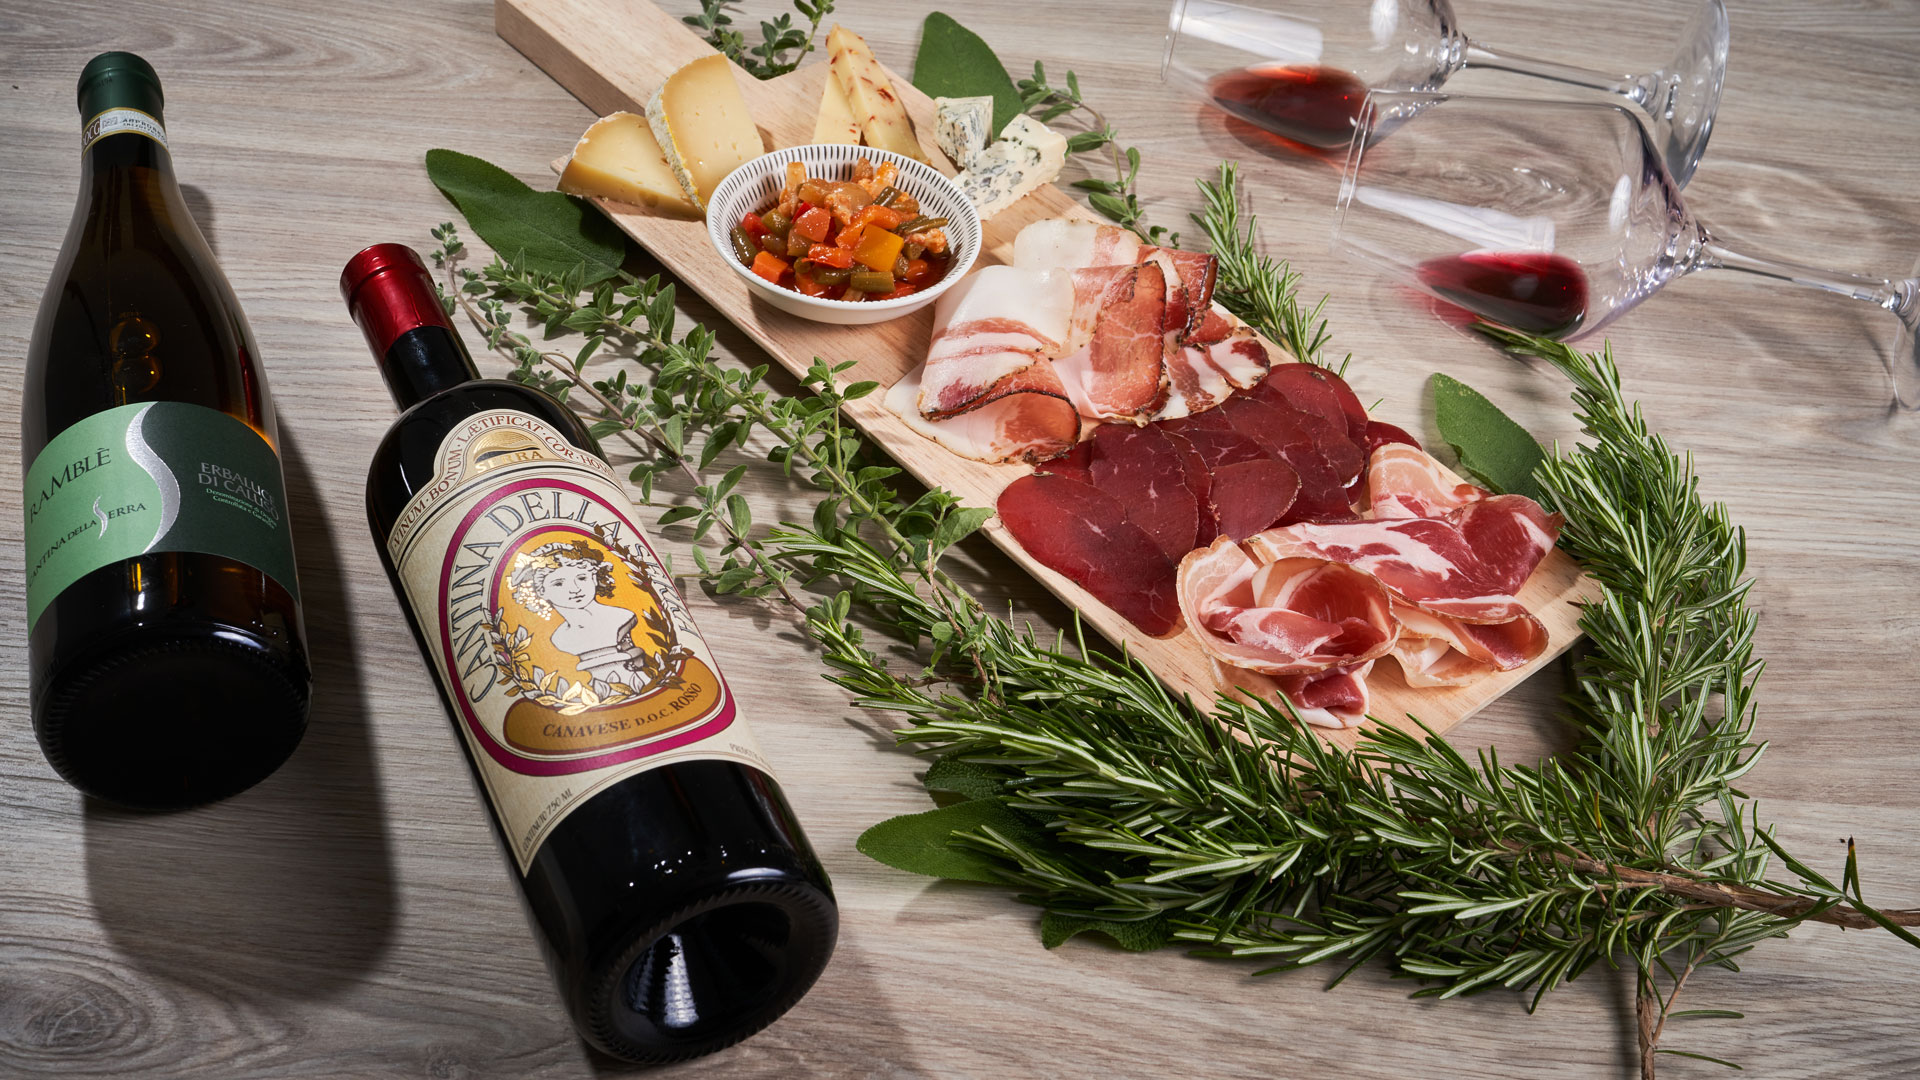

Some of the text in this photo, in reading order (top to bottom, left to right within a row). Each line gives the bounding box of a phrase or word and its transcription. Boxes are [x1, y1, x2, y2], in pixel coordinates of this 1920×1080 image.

[474, 450, 544, 474] SERRA
[198, 472, 280, 521] DI CALUSO
[393, 499, 427, 546] VINUM
[428, 449, 463, 502] BONUM
[544, 436, 575, 459] COR
[67, 520, 97, 541] DELLA
[450, 540, 504, 704] CANTINA
[485, 491, 622, 542] DELLA
[542, 682, 703, 738] CANAVESE D.O.C. ROSSO
[546, 796, 561, 815] 750
